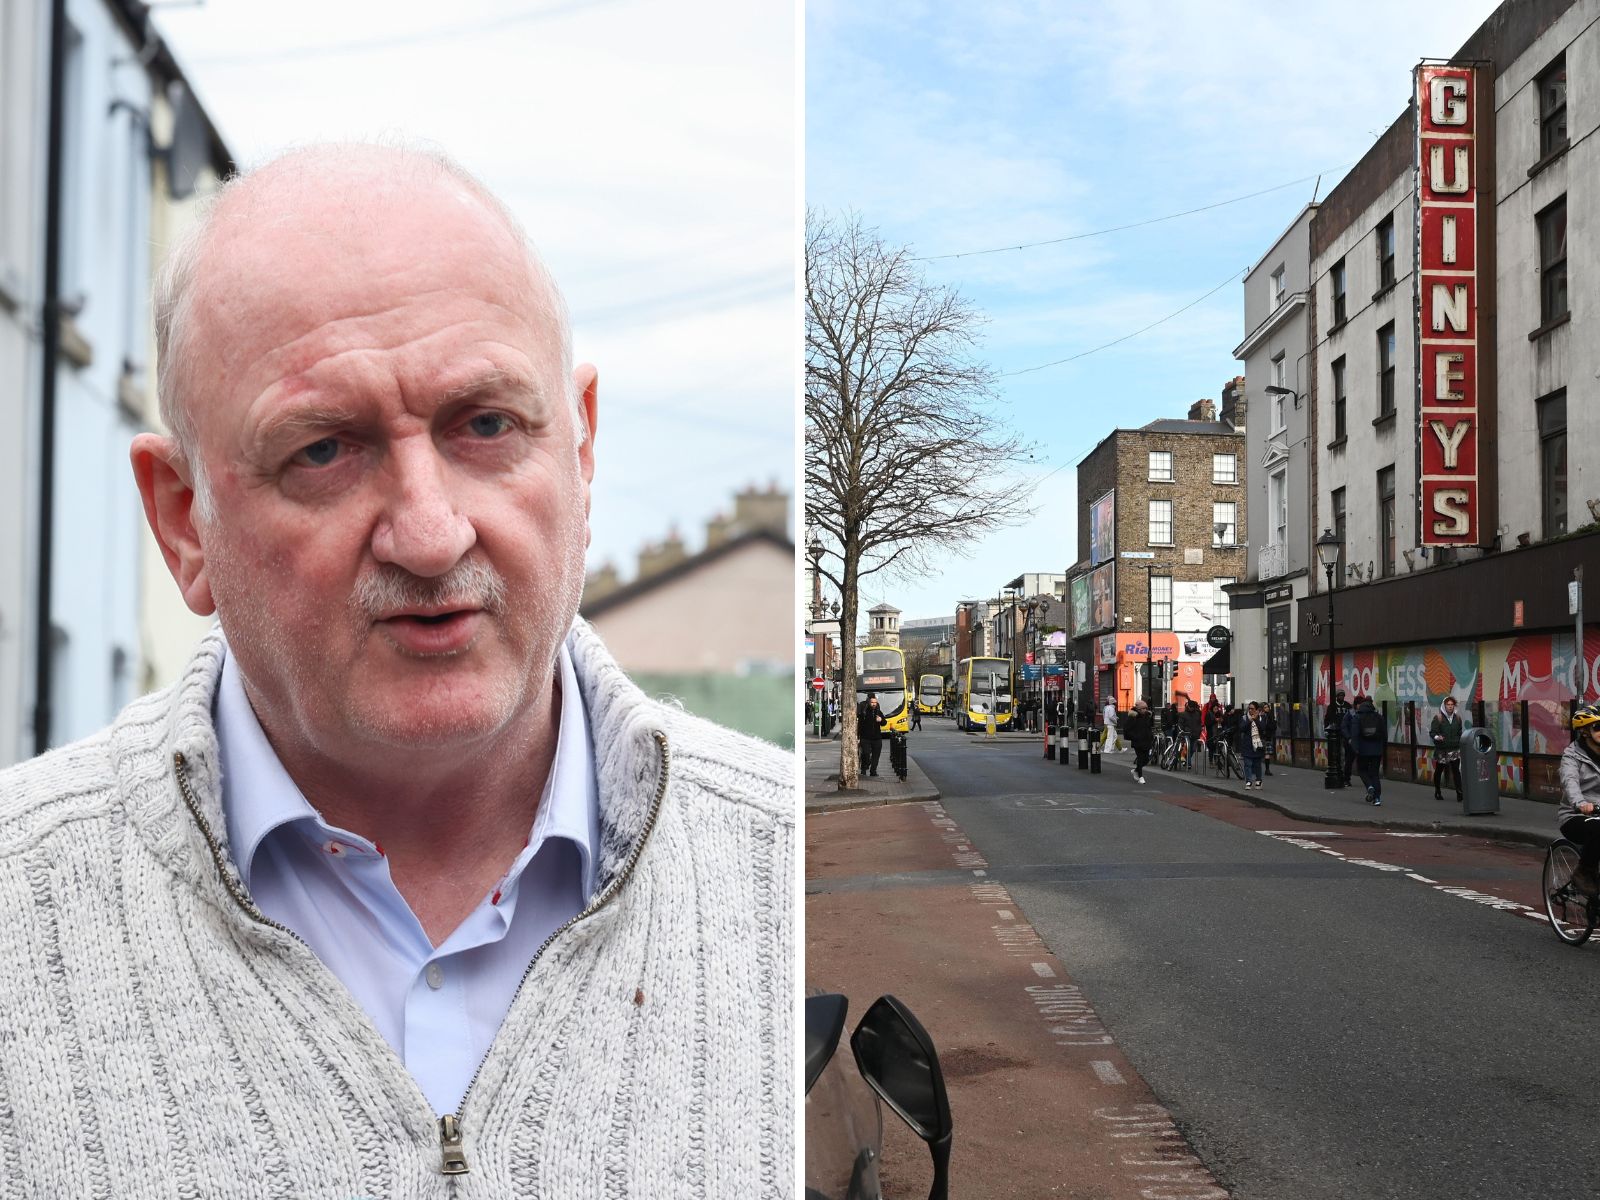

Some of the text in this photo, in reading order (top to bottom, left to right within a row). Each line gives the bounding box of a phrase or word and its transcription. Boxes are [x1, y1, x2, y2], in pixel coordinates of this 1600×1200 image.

[1430, 75, 1472, 537] GUINEYS
[1126, 641, 1151, 655] Ria
[1024, 984, 1114, 1045] LOADING
